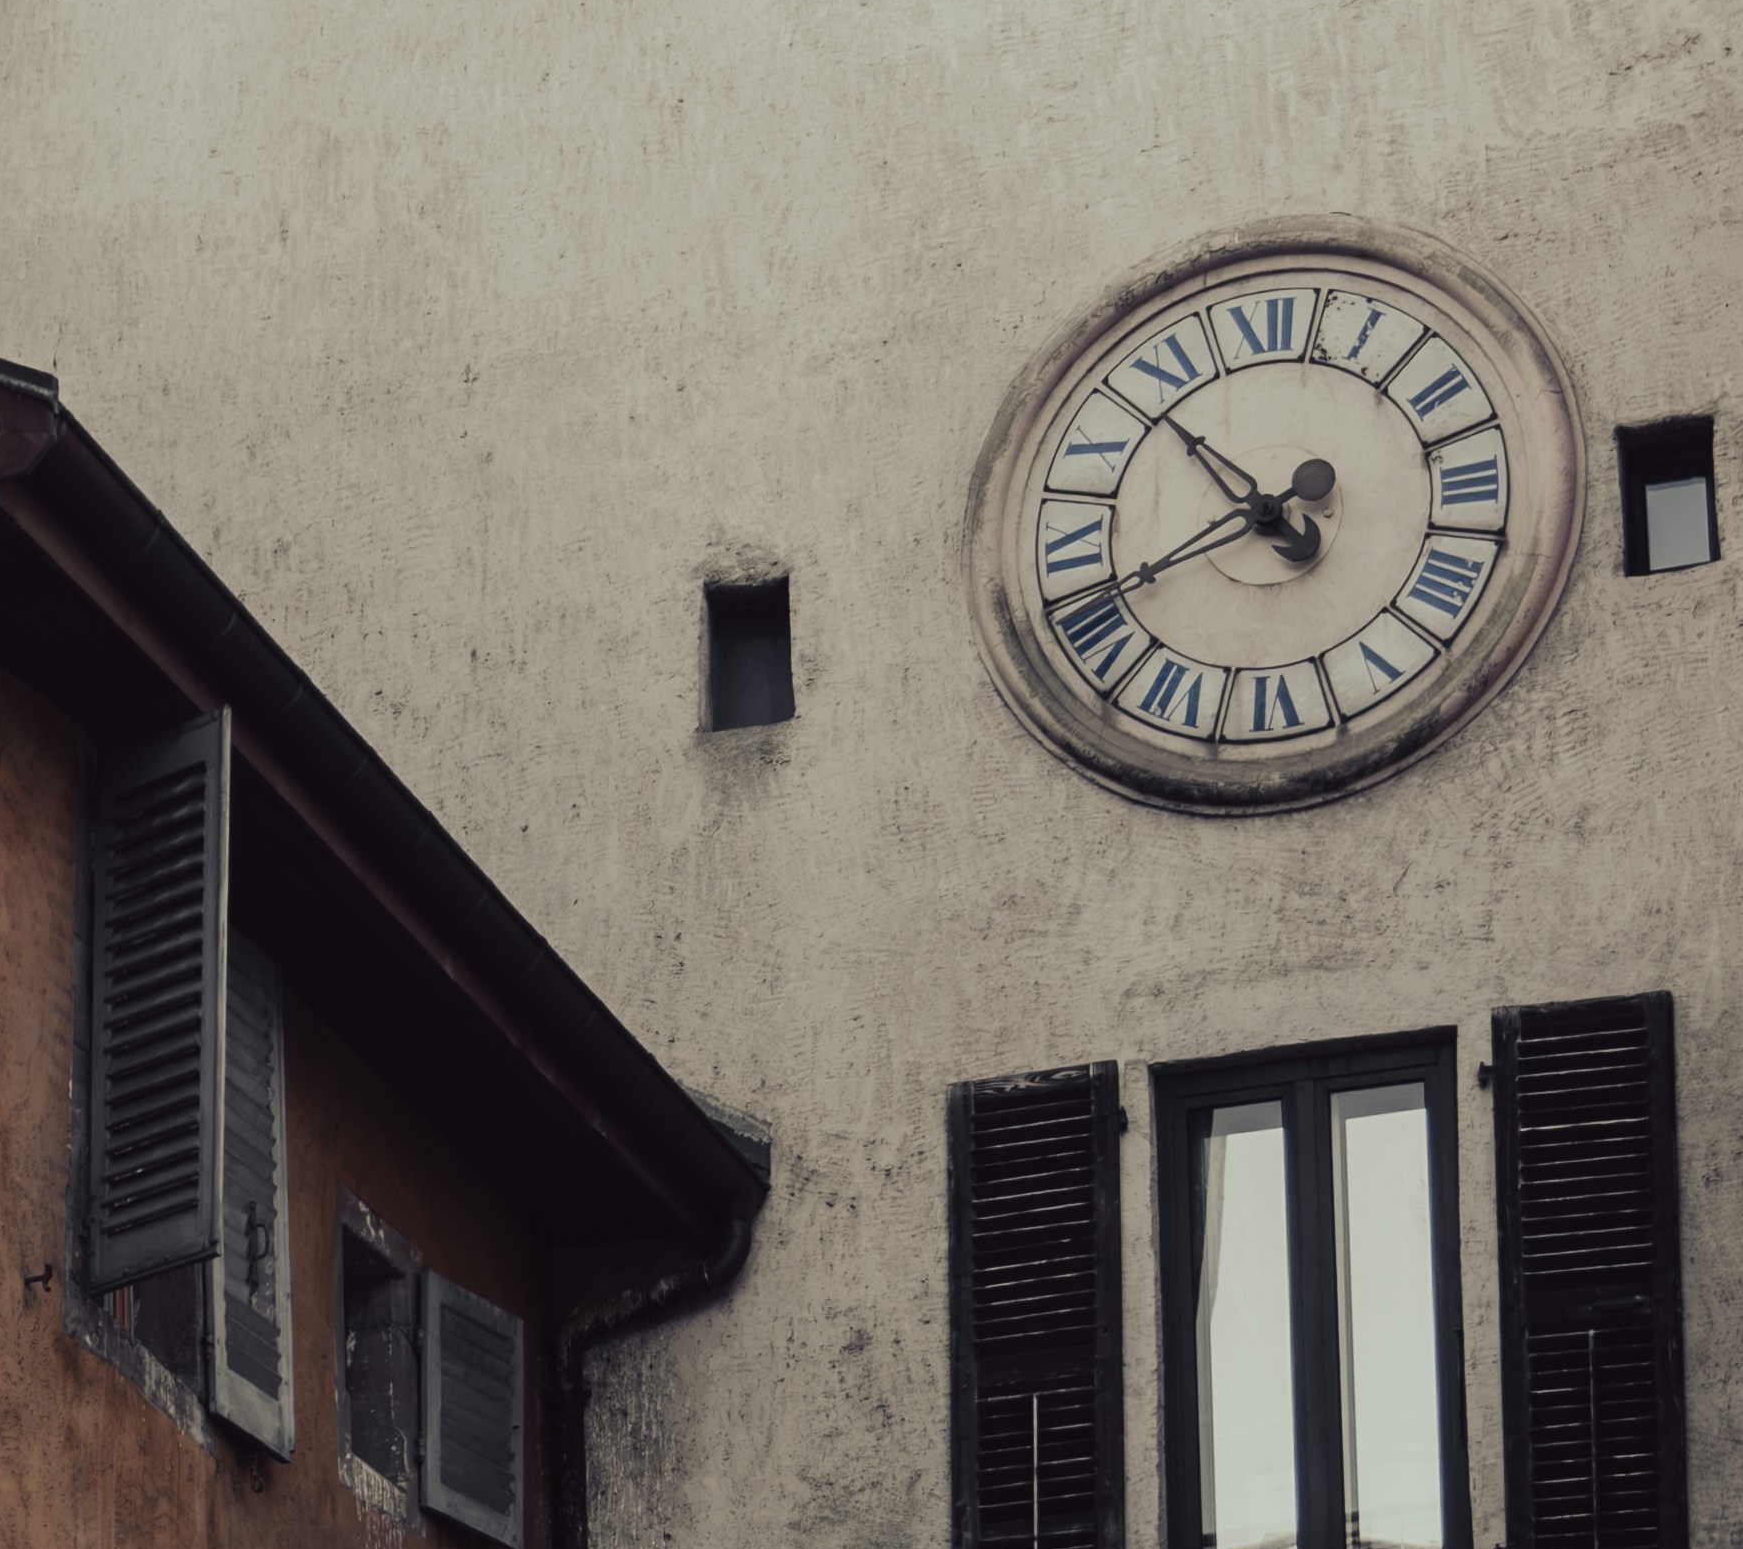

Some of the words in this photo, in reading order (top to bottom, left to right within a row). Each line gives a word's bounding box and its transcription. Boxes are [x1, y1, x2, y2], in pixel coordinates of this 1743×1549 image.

[1227, 296, 1297, 355] XII
[1130, 332, 1199, 402] XI
[1408, 364, 1470, 420] II
[1065, 425, 1129, 472] X
[1439, 454, 1500, 507] III
[1045, 517, 1104, 578] IX
[1406, 549, 1483, 620] IIII
[1139, 658, 1204, 729] VII
[1359, 641, 1406, 694] V
[1251, 674, 1304, 732] VI
